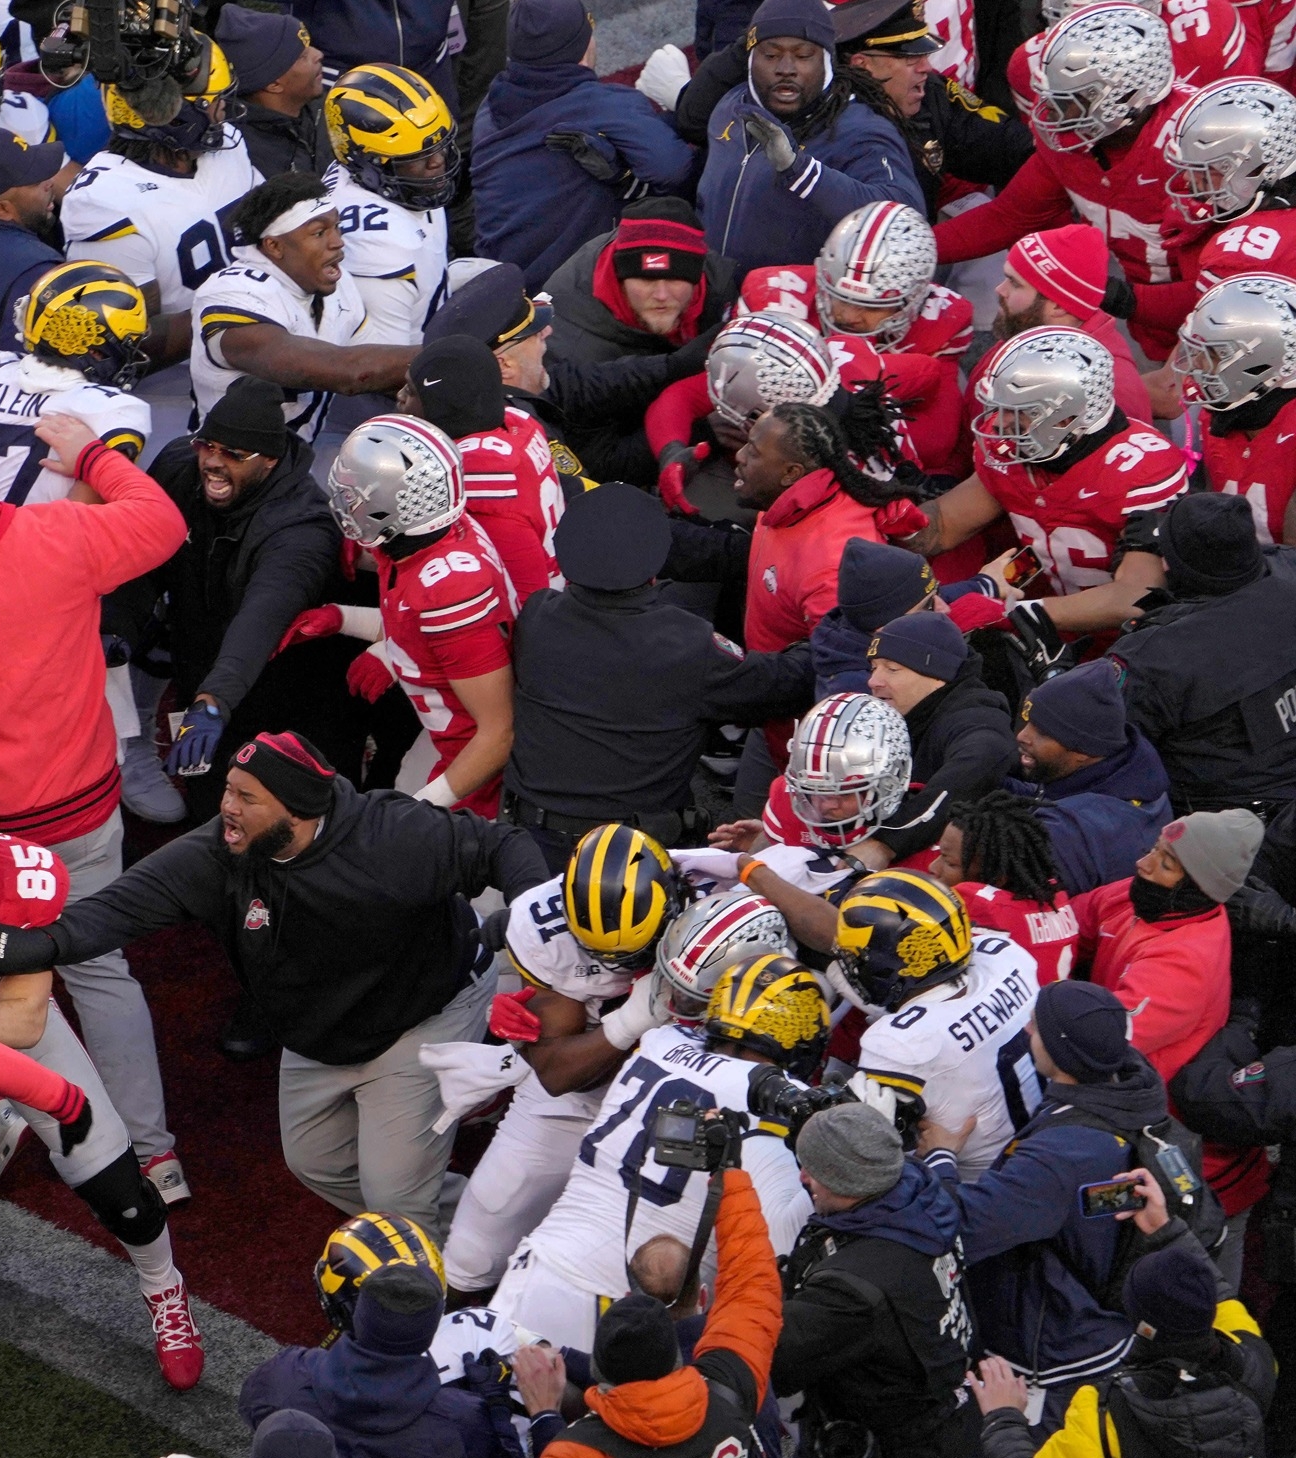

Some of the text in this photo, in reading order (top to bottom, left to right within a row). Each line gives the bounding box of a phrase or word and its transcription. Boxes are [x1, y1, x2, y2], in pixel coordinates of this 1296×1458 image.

[1216, 225, 1281, 260] 49
[418, 550, 482, 588] 86
[949, 968, 1034, 1053] STEWART
[661, 1042, 732, 1078] GRANT
